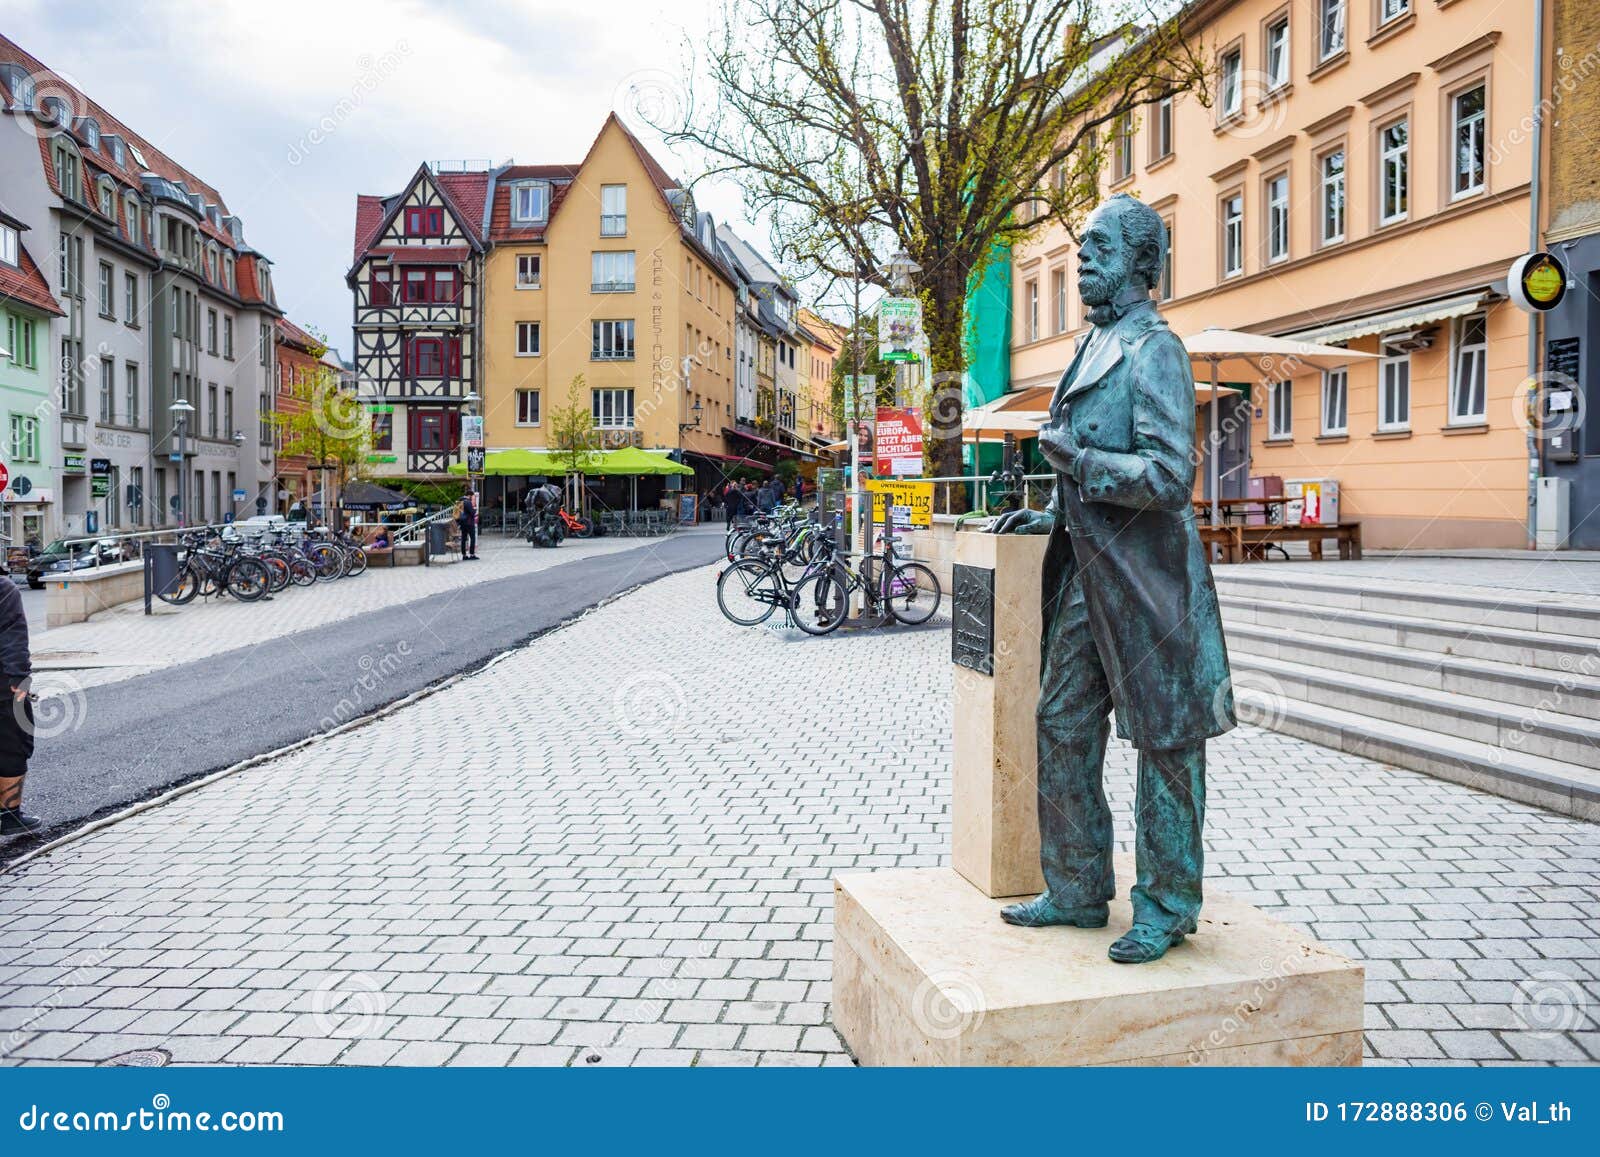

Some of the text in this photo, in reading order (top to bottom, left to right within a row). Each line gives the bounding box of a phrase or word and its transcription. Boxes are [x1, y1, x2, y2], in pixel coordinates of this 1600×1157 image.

[877, 434, 922, 445] JETZT ABER
[877, 444, 913, 454] RICHTIG!
